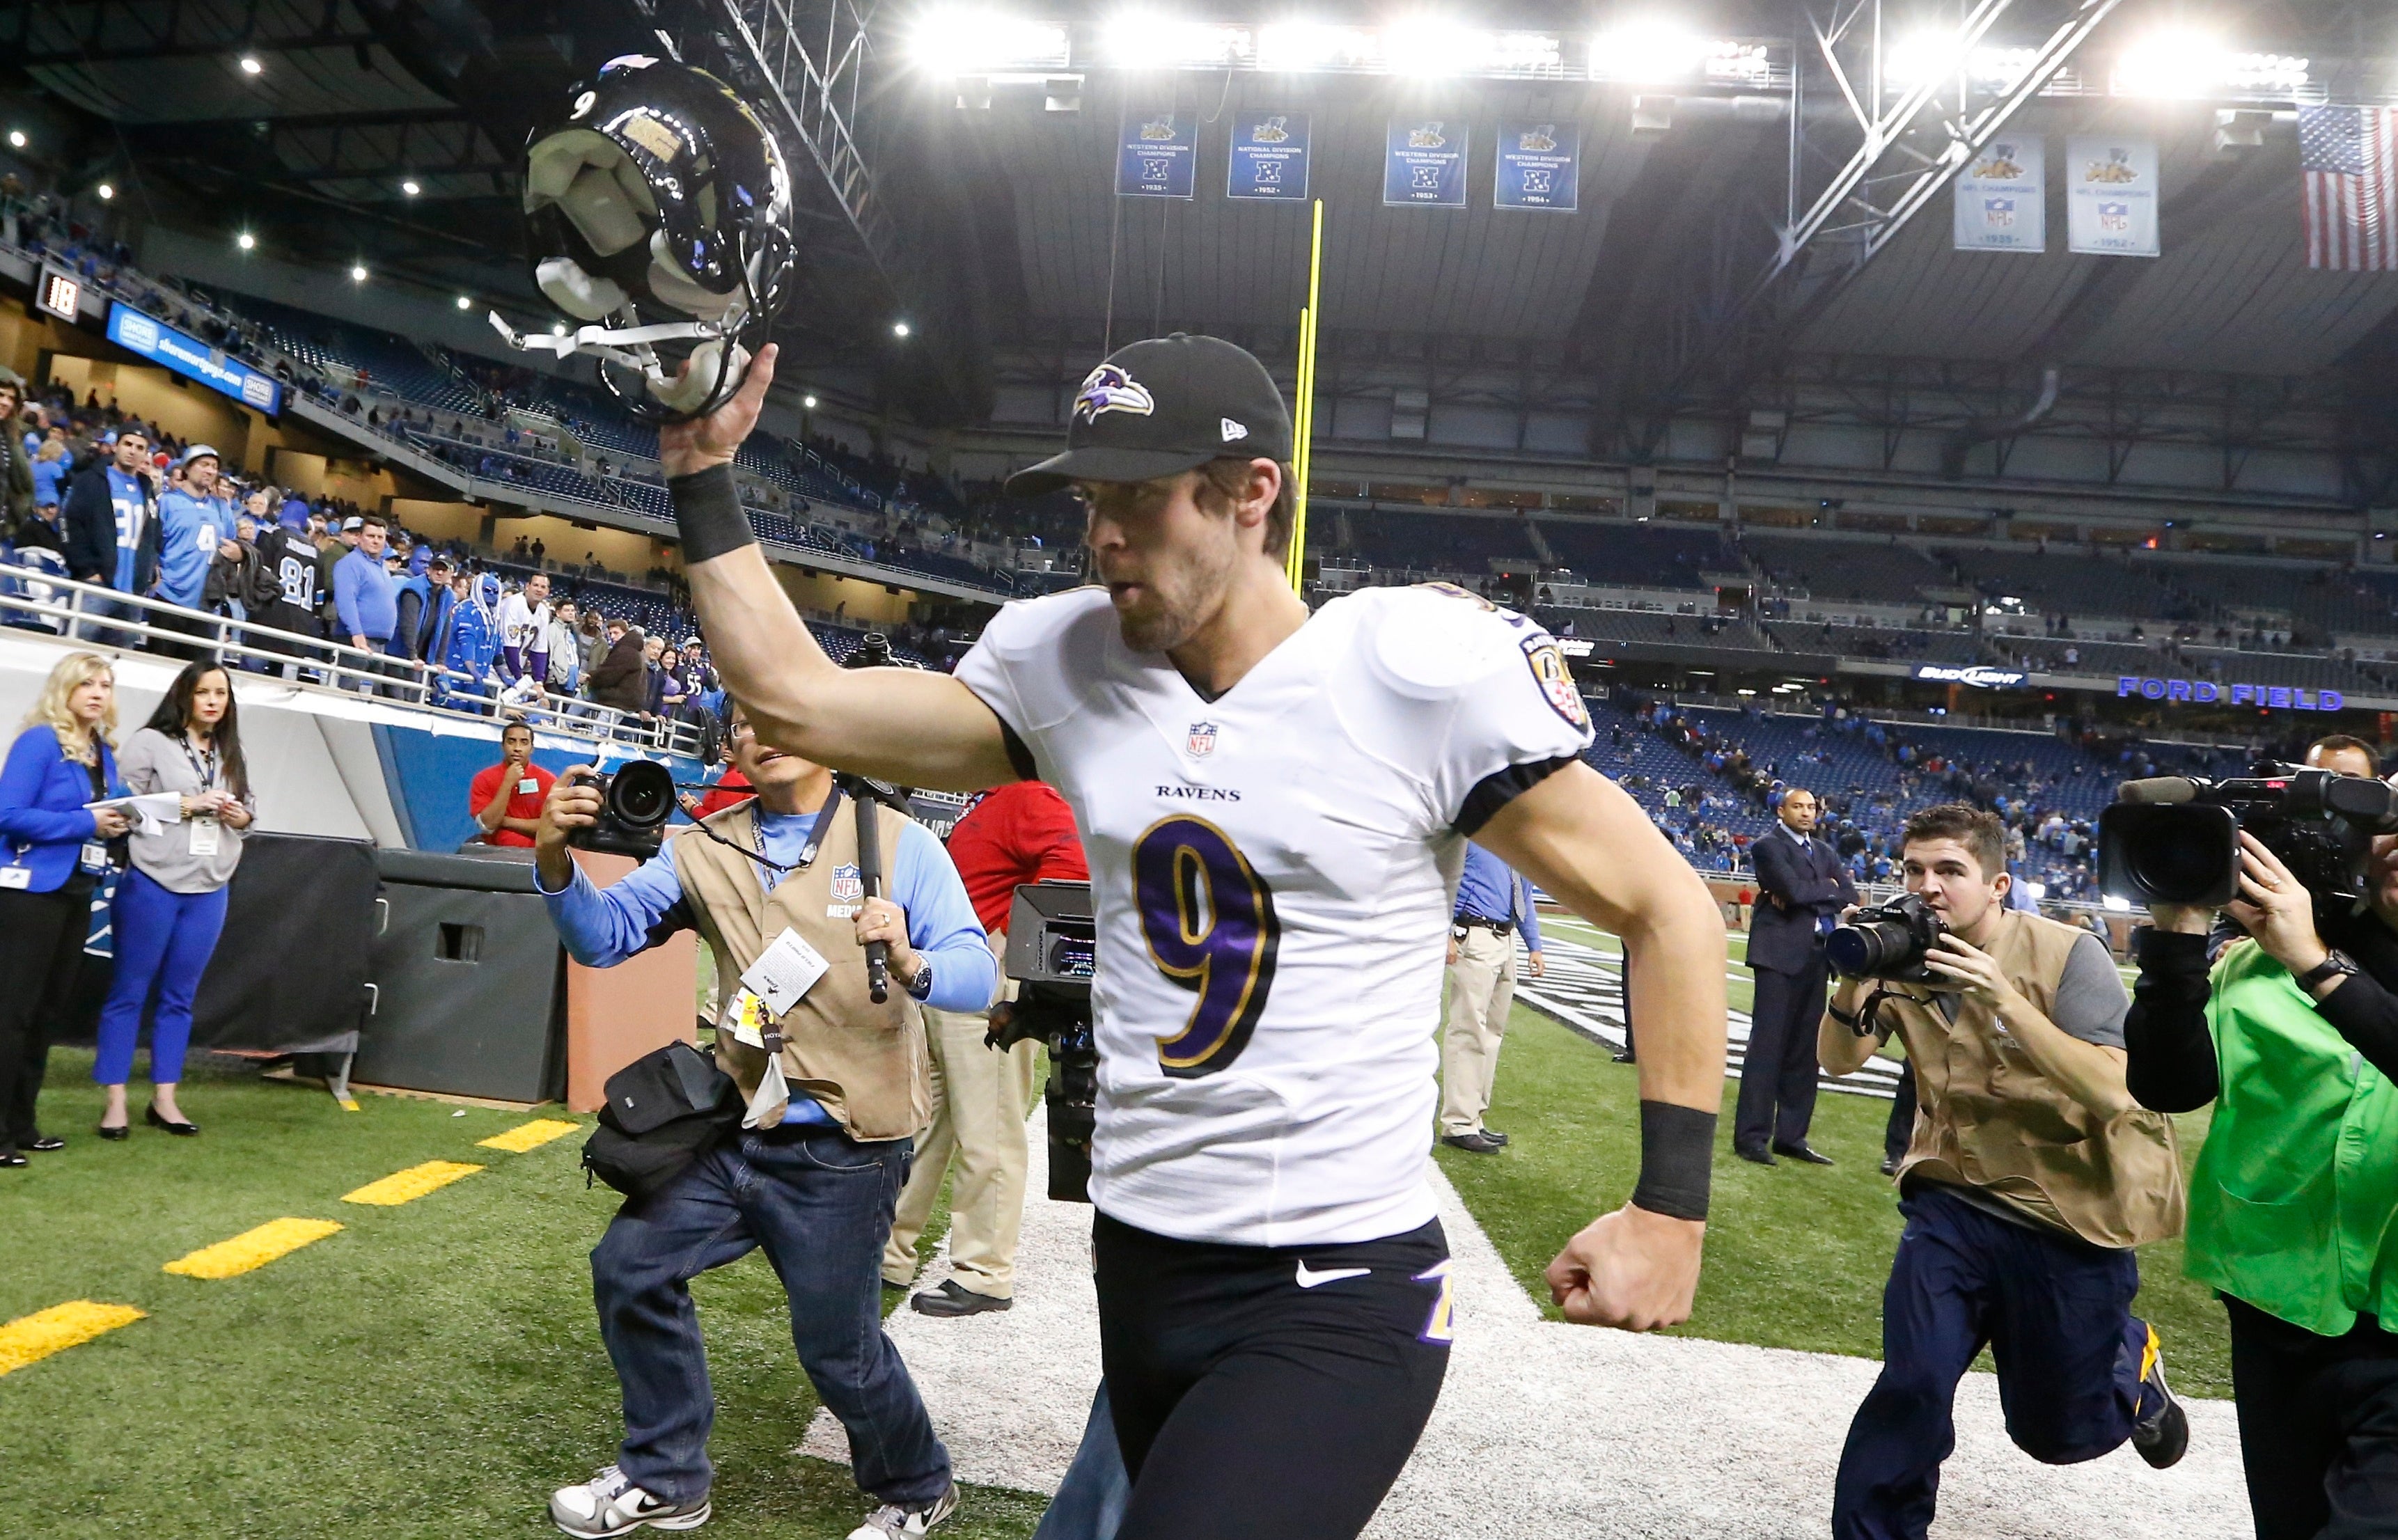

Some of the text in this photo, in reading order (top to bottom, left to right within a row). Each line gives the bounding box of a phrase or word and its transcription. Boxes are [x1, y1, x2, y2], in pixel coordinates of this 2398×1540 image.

[570, 91, 596, 120] 9
[49, 276, 77, 315] 18
[123, 316, 153, 340] SHORE
[246, 378, 270, 395] SHORE
[279, 556, 315, 612] 81
[686, 673, 702, 696] 55
[1918, 666, 2023, 684] BUD LIGHT
[2117, 677, 2345, 712] FORD FIELD
[1189, 737, 1212, 753] NFL
[1155, 785, 1241, 802] RAVENS
[835, 879, 859, 896] NFL
[1131, 812, 1280, 1078] 9
